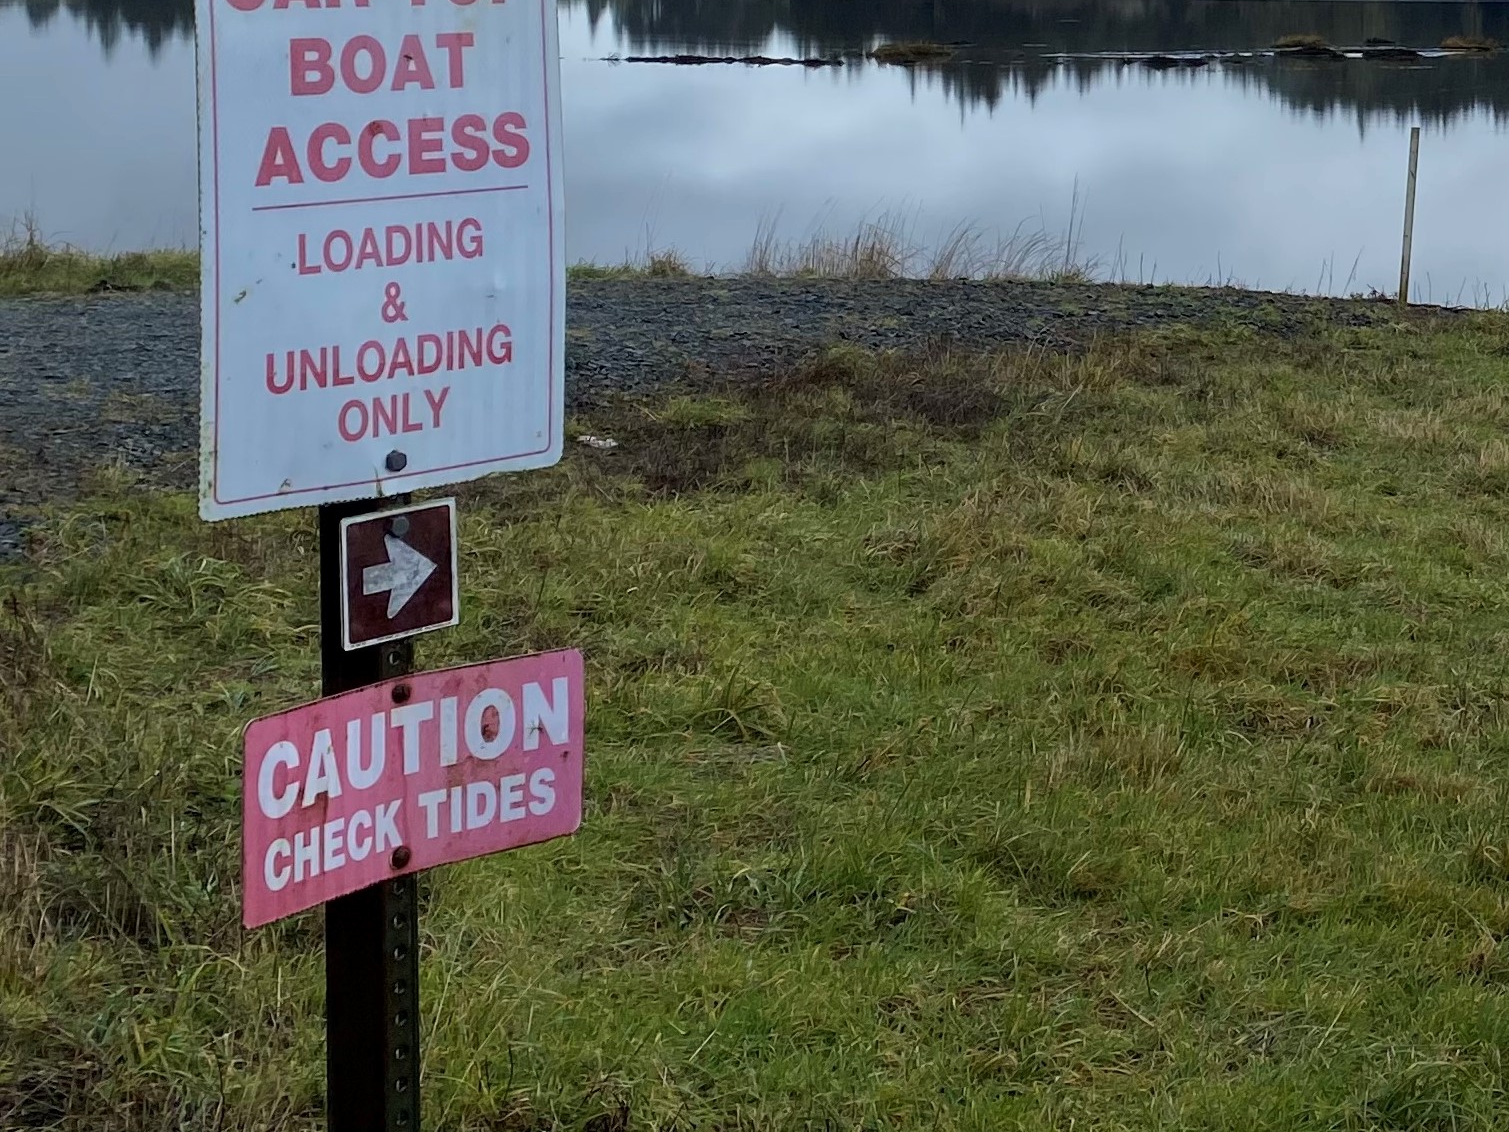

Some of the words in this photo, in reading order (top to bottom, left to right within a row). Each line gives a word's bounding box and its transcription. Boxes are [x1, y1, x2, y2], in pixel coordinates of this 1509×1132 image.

[289, 32, 474, 96] BOAT
[255, 112, 530, 186] ACCESS
[297, 218, 483, 275] LOADING
[381, 281, 408, 323] &
[265, 324, 512, 394] UNLOADING
[338, 386, 450, 442] ONLY
[257, 677, 570, 819] CAUTION
[264, 799, 404, 891] CHECK
[418, 768, 556, 839] TIDES
